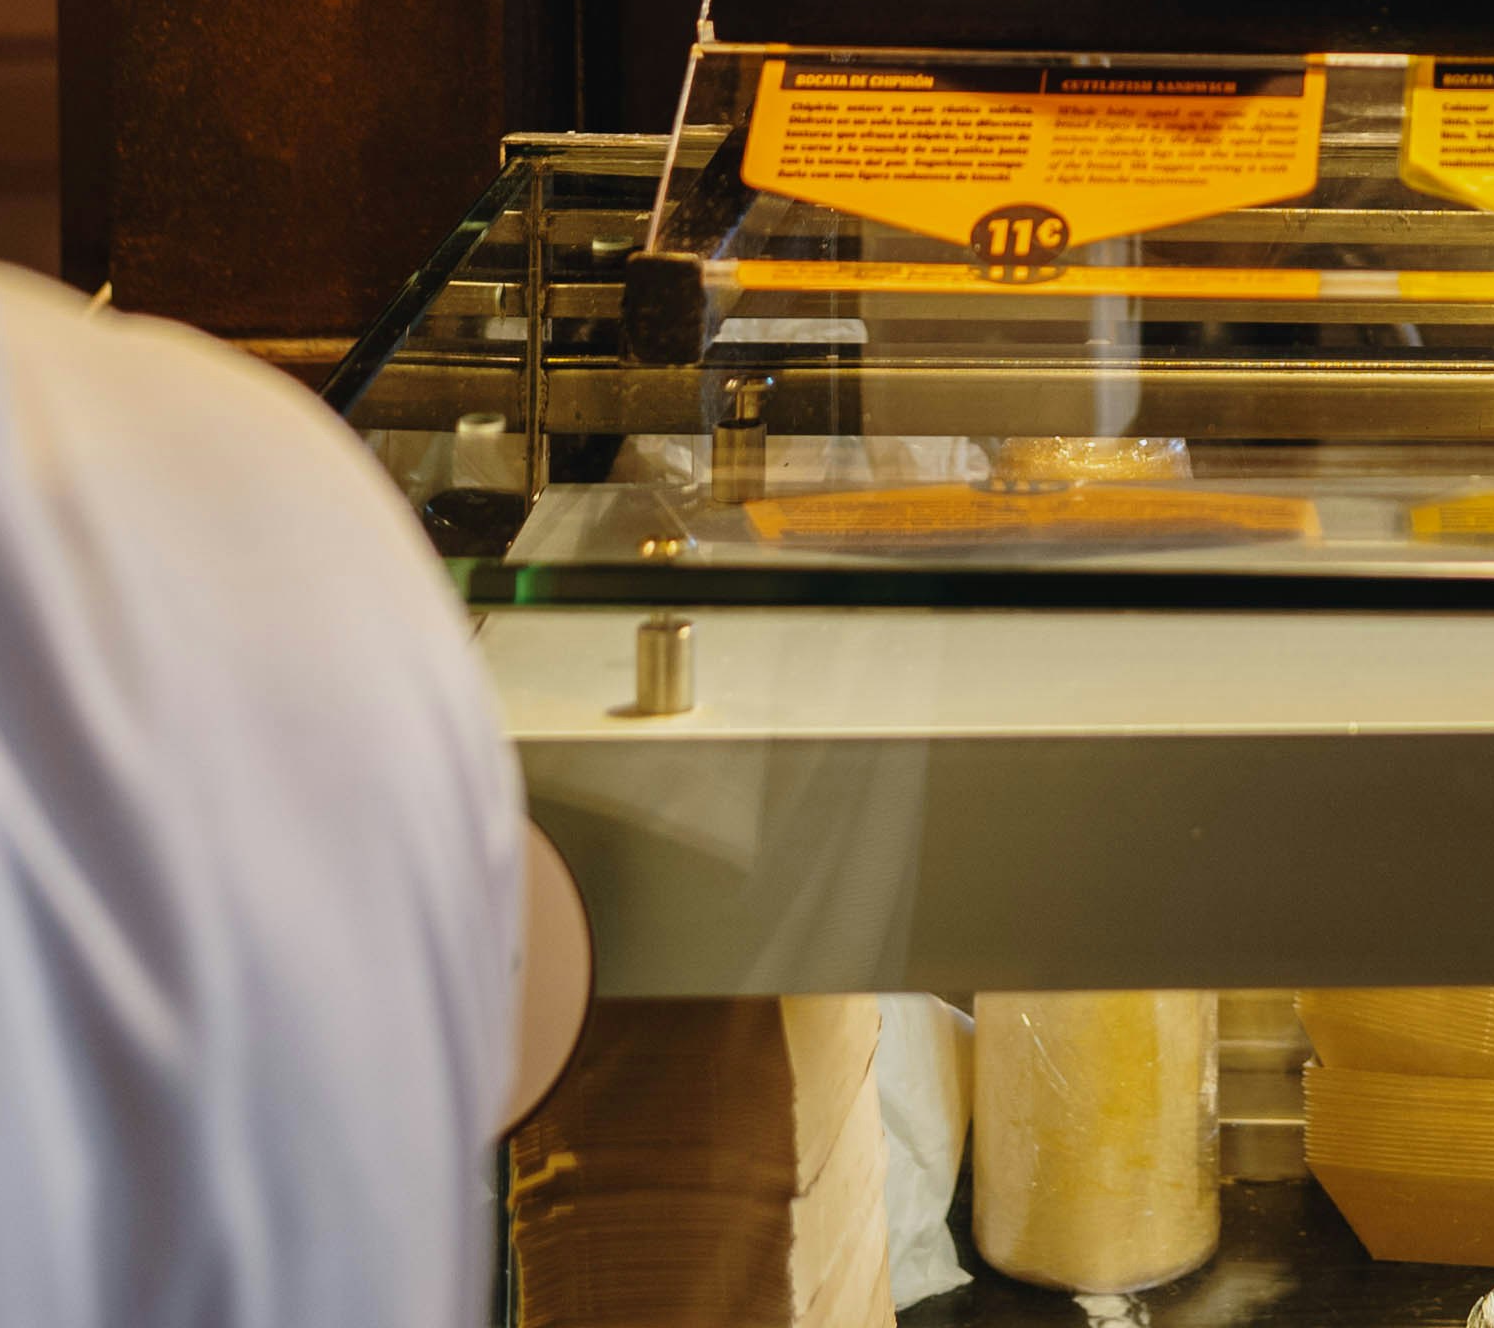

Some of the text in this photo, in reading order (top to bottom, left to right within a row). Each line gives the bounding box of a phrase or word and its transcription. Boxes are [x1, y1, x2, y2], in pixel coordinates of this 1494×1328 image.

[795, 74, 848, 87] BOCATA
[850, 75, 867, 87] DE
[987, 217, 1063, 258] 11€
